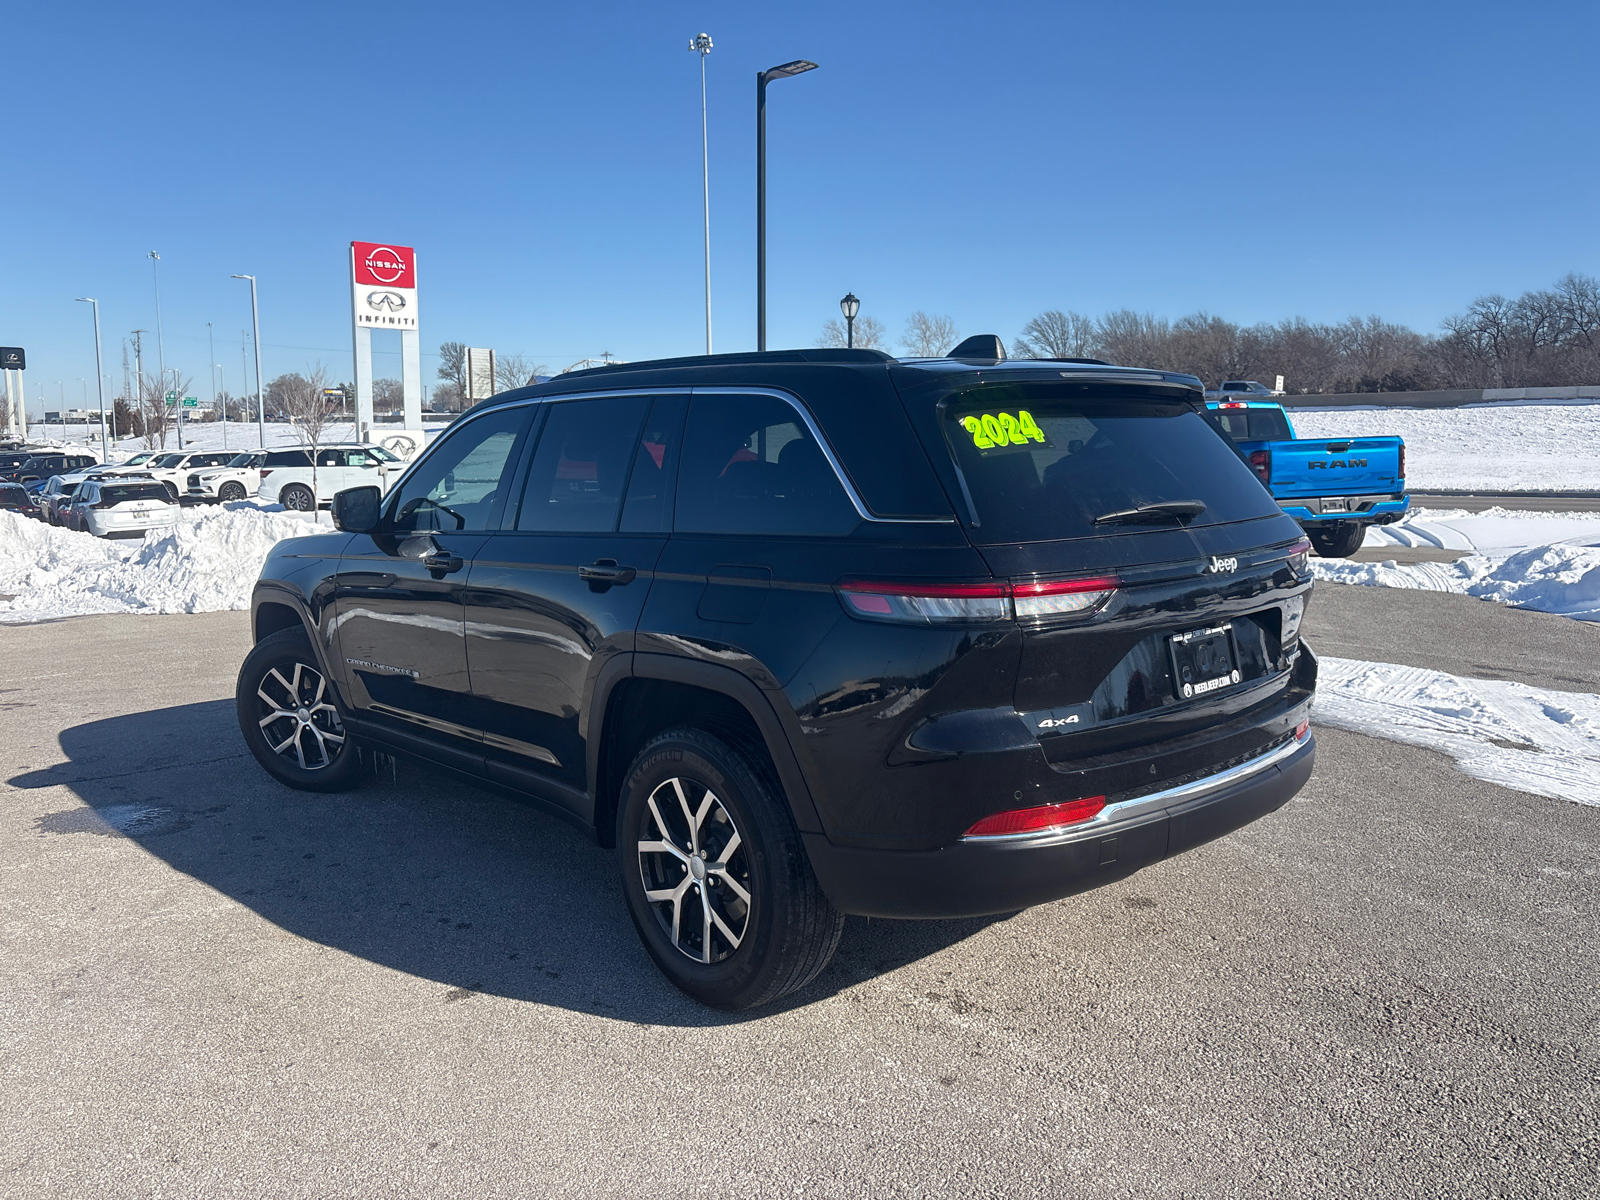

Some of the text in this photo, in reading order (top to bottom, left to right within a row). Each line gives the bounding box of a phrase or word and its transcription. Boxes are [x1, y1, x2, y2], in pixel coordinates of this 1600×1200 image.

[365, 260, 405, 270] NISSAN
[359, 315, 414, 326] INFINITI
[964, 410, 1045, 449] 2024
[1308, 459, 1367, 469] RAM
[1210, 556, 1237, 573] Jeep
[346, 658, 412, 675] GRAND CHEROKEE
[1038, 714, 1079, 728] 4x4
[642, 751, 681, 771] MICHELIN
